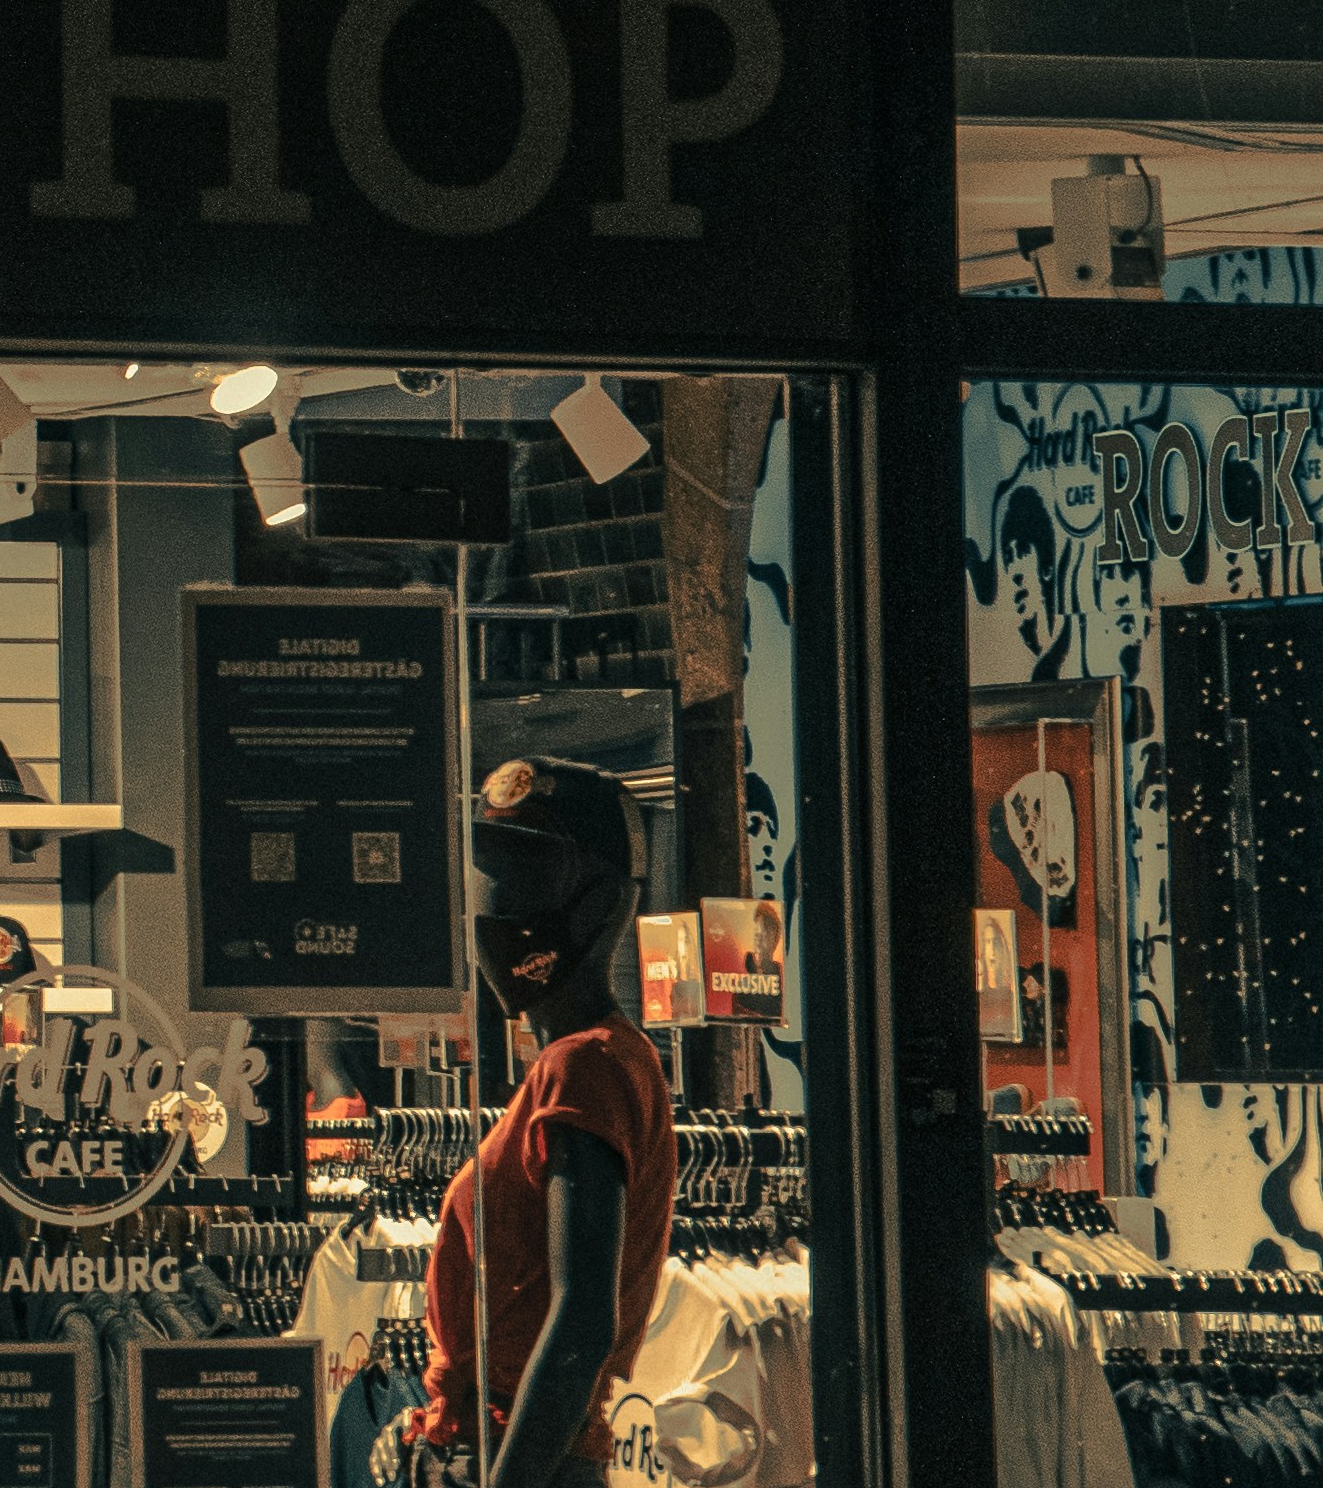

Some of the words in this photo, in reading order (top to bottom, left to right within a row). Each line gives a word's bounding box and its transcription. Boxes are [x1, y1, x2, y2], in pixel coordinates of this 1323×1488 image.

[1093, 409, 1315, 565] ROCK
[710, 971, 780, 996] EXCLUSIVE
[82, 1019, 271, 1127] Rock
[25, 1140, 125, 1178] CAFE
